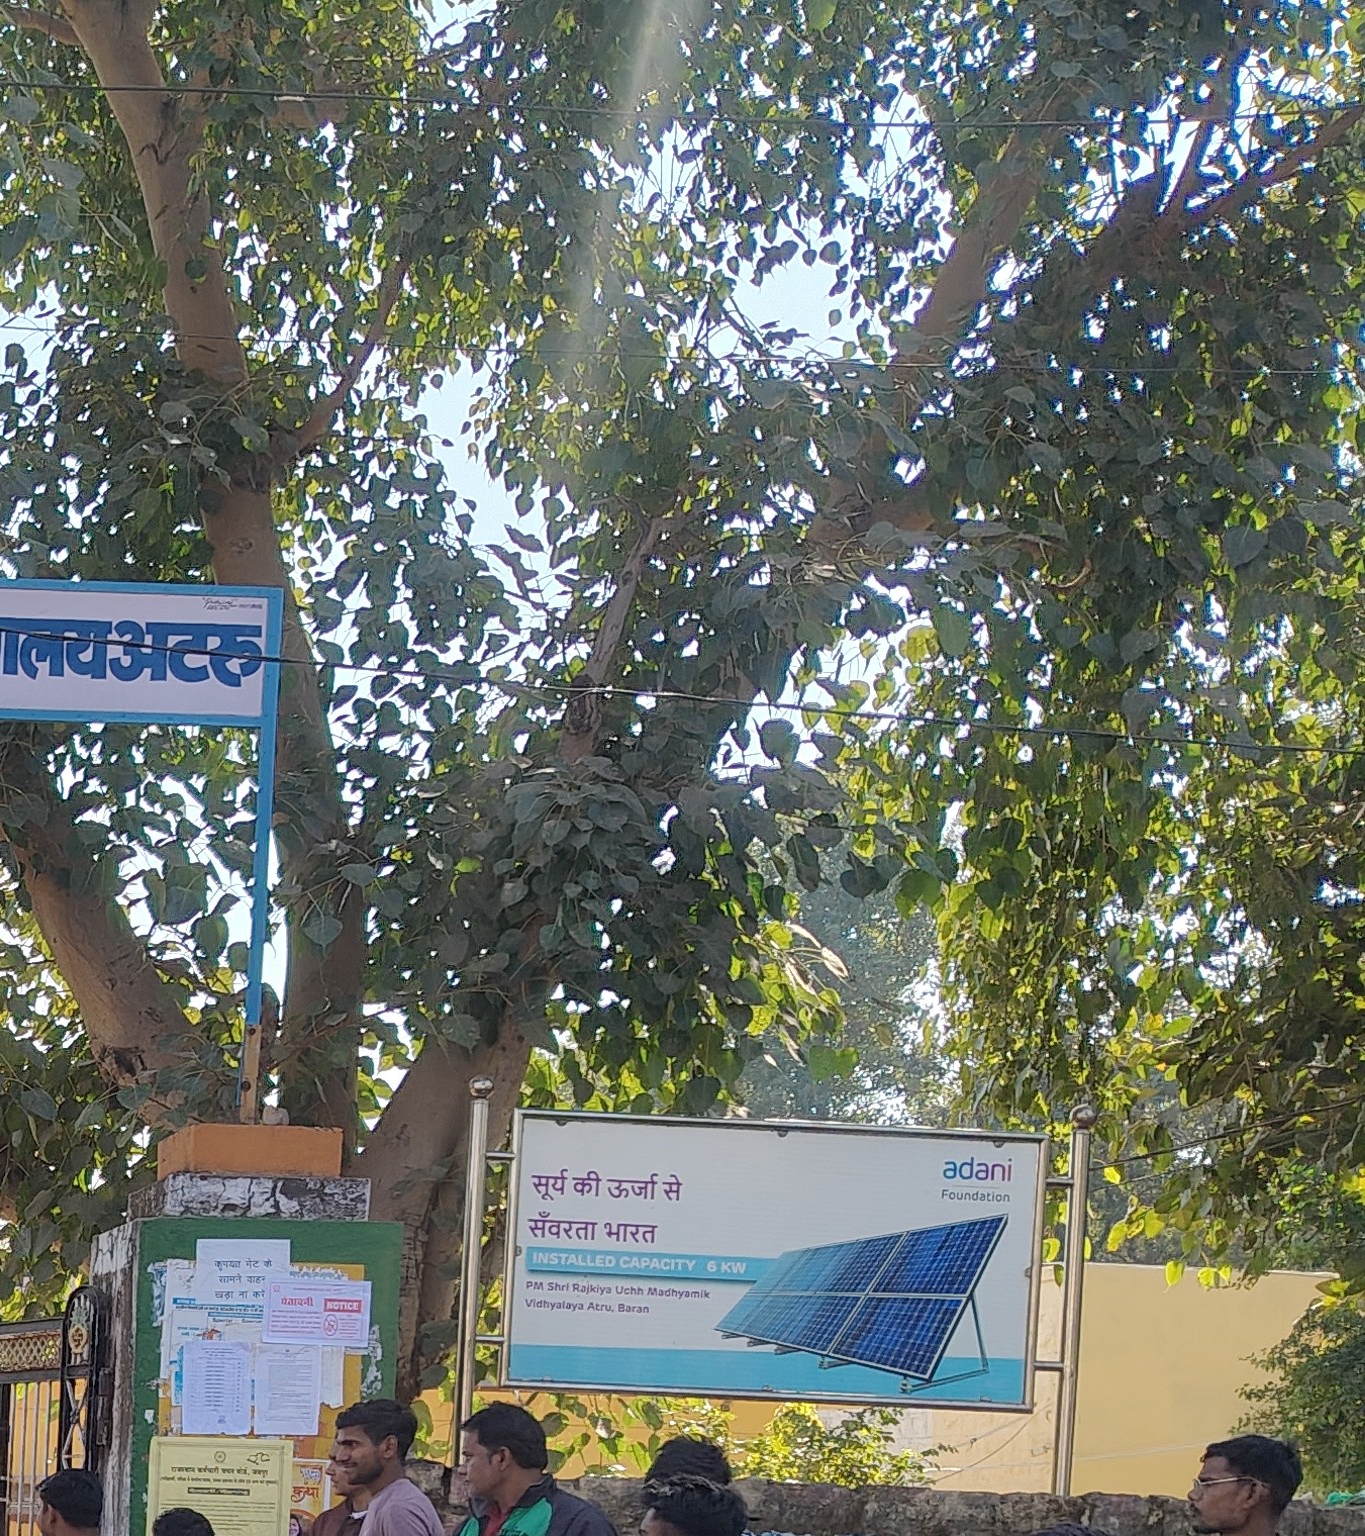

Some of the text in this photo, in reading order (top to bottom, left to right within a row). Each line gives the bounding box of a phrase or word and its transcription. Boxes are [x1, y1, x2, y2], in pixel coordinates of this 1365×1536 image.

[941, 1156, 1012, 1184] adani
[530, 1170, 683, 1203] सूर्य की ऊर्जा से
[941, 1189, 1011, 1203] Foundation
[604, 1219, 658, 1245] भारत
[532, 1251, 747, 1274] INSTALLED CAPACITY 6 KW
[525, 1280, 710, 1300] PM Shri Rajkiya Uchh Madhyamik
[326, 1300, 360, 1311] NOTICE
[525, 1298, 650, 1315] Vidhyalaya Atru, Baran
